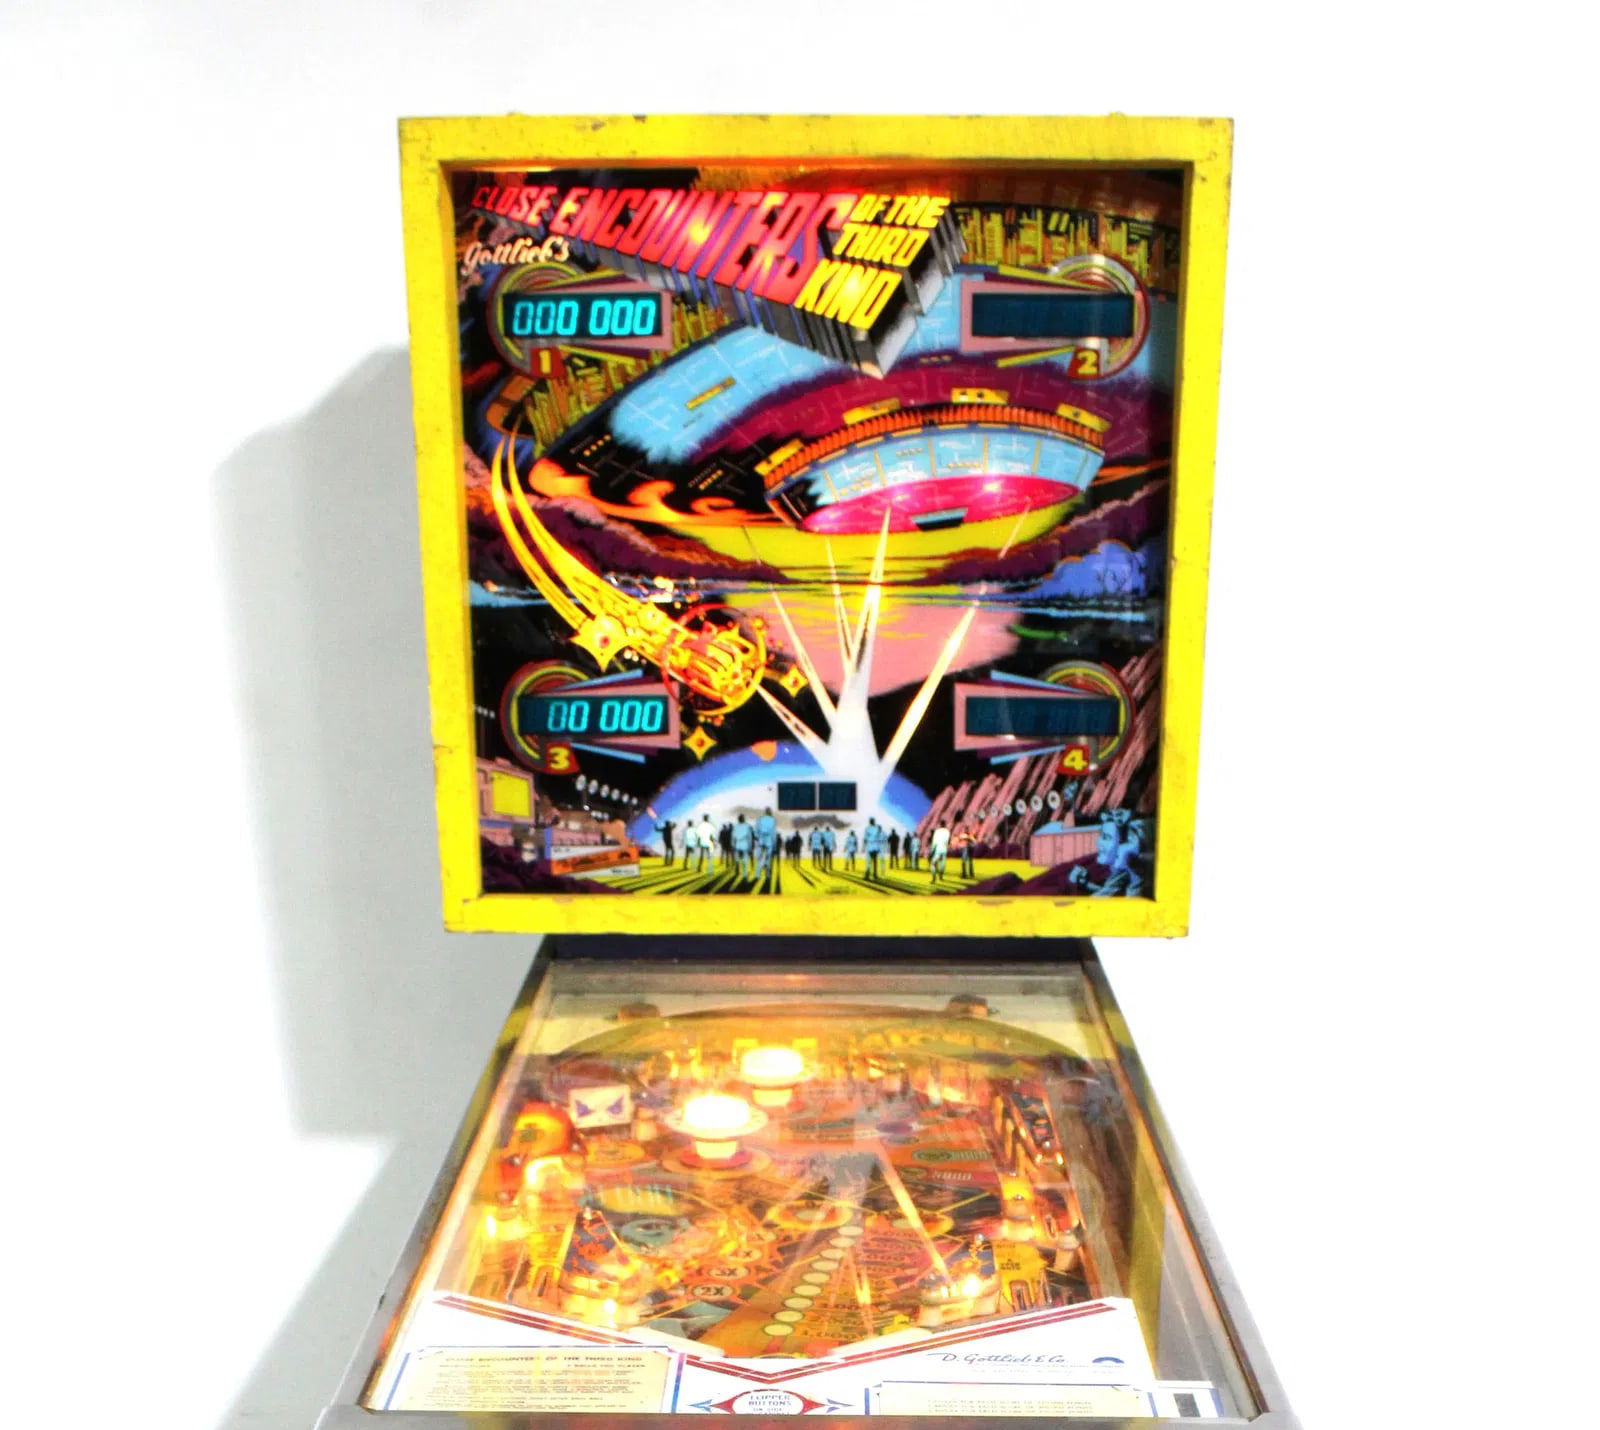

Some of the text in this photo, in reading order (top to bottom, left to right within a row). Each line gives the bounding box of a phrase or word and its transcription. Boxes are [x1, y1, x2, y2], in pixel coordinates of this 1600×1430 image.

[849, 193, 951, 229] OF THE
[460, 235, 570, 277] Gottlieb's
[473, 186, 858, 305] CLOSE ENCOUNTERS
[832, 222, 930, 268] THIRD
[794, 258, 903, 330] KIND
[512, 299, 656, 337] 000 000
[540, 349, 551, 374] 1
[1077, 350, 1099, 376] 2
[547, 701, 664, 732] 00 000
[549, 746, 571, 771] 3
[1062, 749, 1088, 772] 4
[700, 1286, 725, 1297] 2X
[963, 1352, 1033, 1365] Gottlieb
